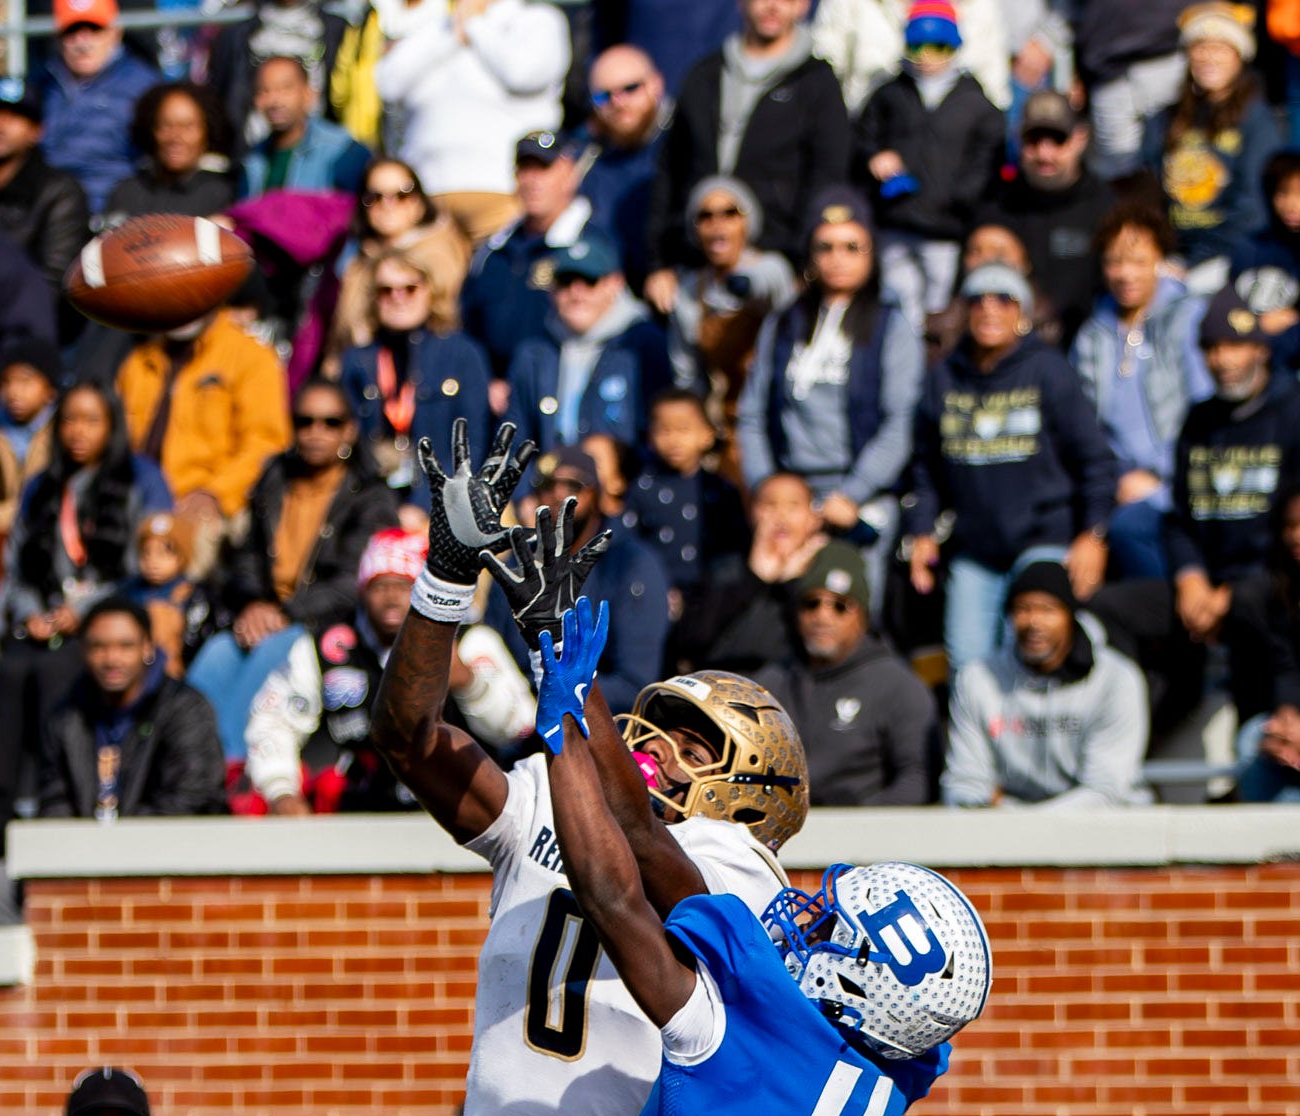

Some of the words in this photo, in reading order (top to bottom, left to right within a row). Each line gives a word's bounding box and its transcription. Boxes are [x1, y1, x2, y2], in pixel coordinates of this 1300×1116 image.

[528, 825, 567, 875] REI
[523, 884, 602, 1062] 0
[856, 889, 946, 987] B
